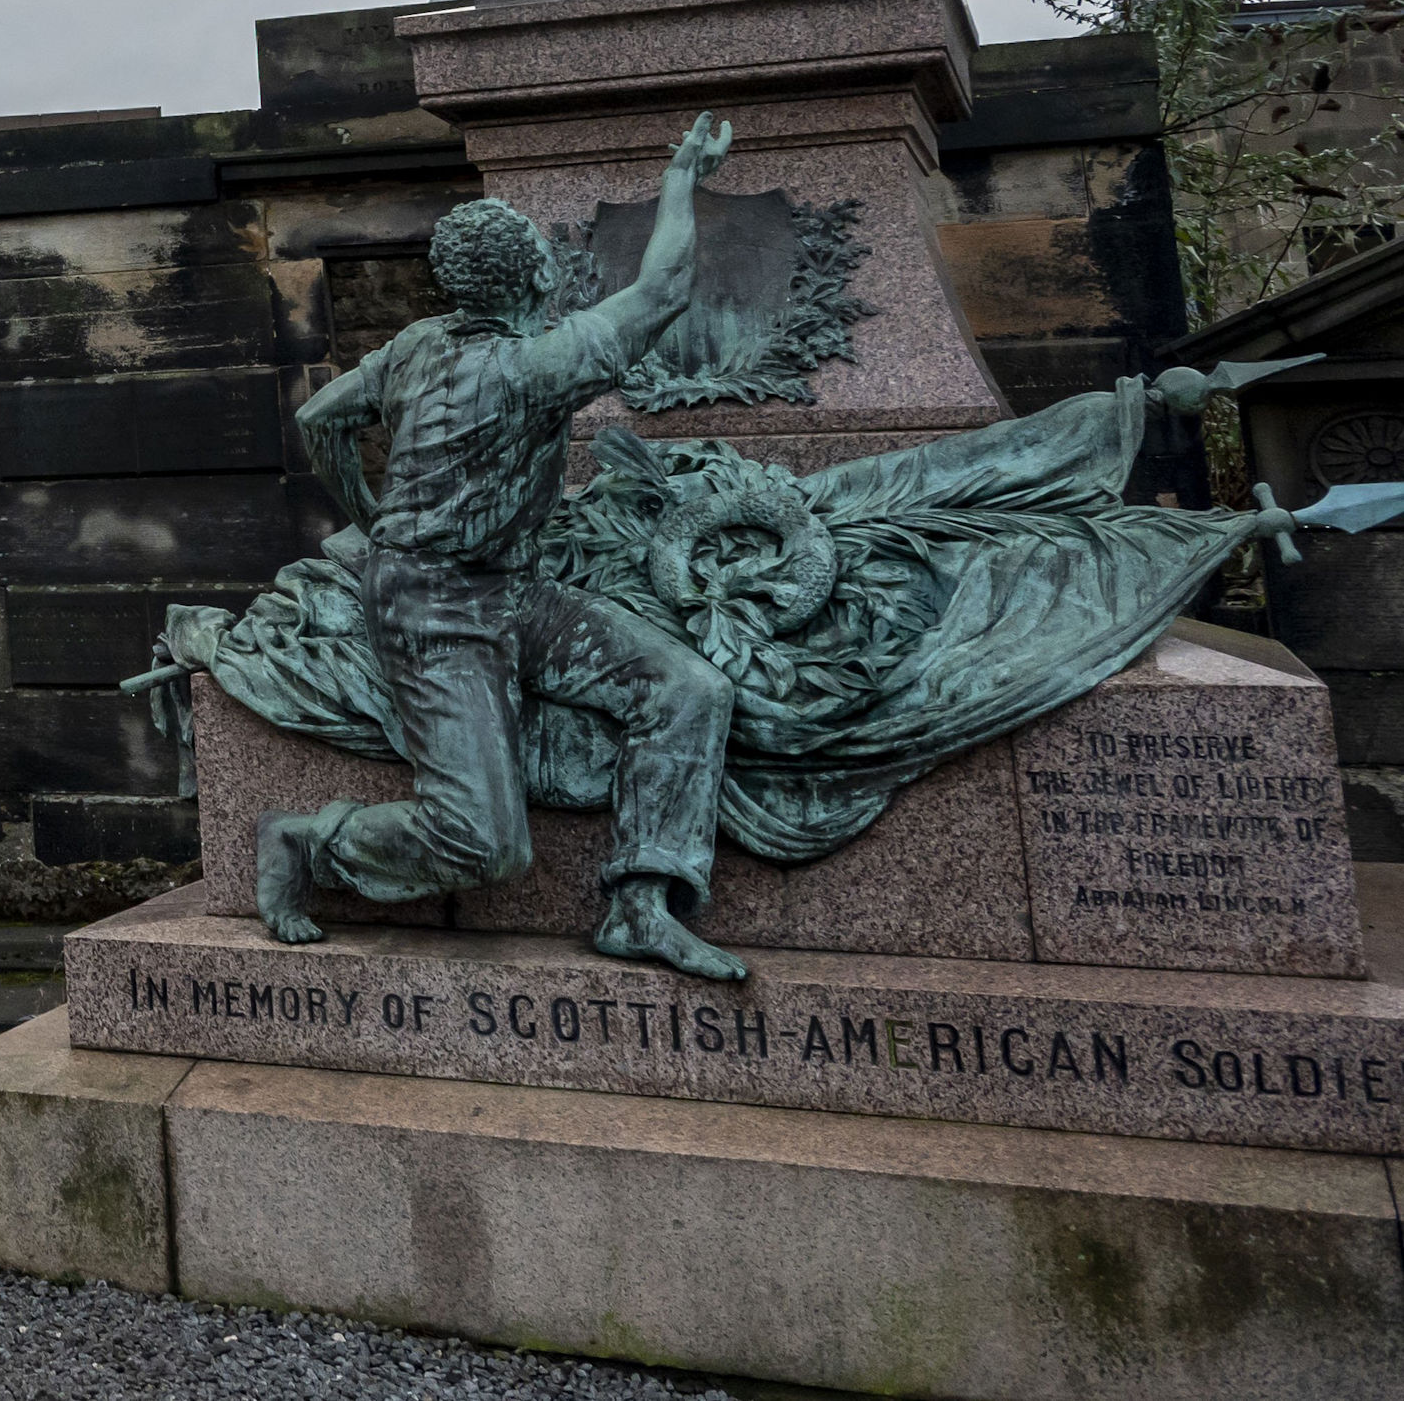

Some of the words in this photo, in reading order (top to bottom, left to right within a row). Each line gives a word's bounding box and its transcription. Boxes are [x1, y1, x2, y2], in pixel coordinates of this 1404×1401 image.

[1127, 734, 1256, 761] PRESERVE
[1026, 770, 1074, 795] THE
[1085, 772, 1166, 798] JEWEL
[1174, 775, 1204, 799] OF
[1218, 773, 1329, 801] LIBERTY
[1042, 810, 1068, 834] IN
[1077, 812, 1125, 836] THE
[1136, 813, 1285, 841] FRAMEWORK
[1296, 817, 1327, 841] OF
[1129, 849, 1244, 878] FREEDOM
[1075, 886, 1187, 911] ABRAHAM
[1198, 890, 1306, 915] LINCOLN
[128, 968, 171, 1013] IN
[192, 979, 357, 1028] MEMORY
[382, 993, 433, 1035] OF
[469, 991, 1131, 1086] SCOTTISH-AMERICAN
[1172, 1038, 1404, 1105] SOLDIE
